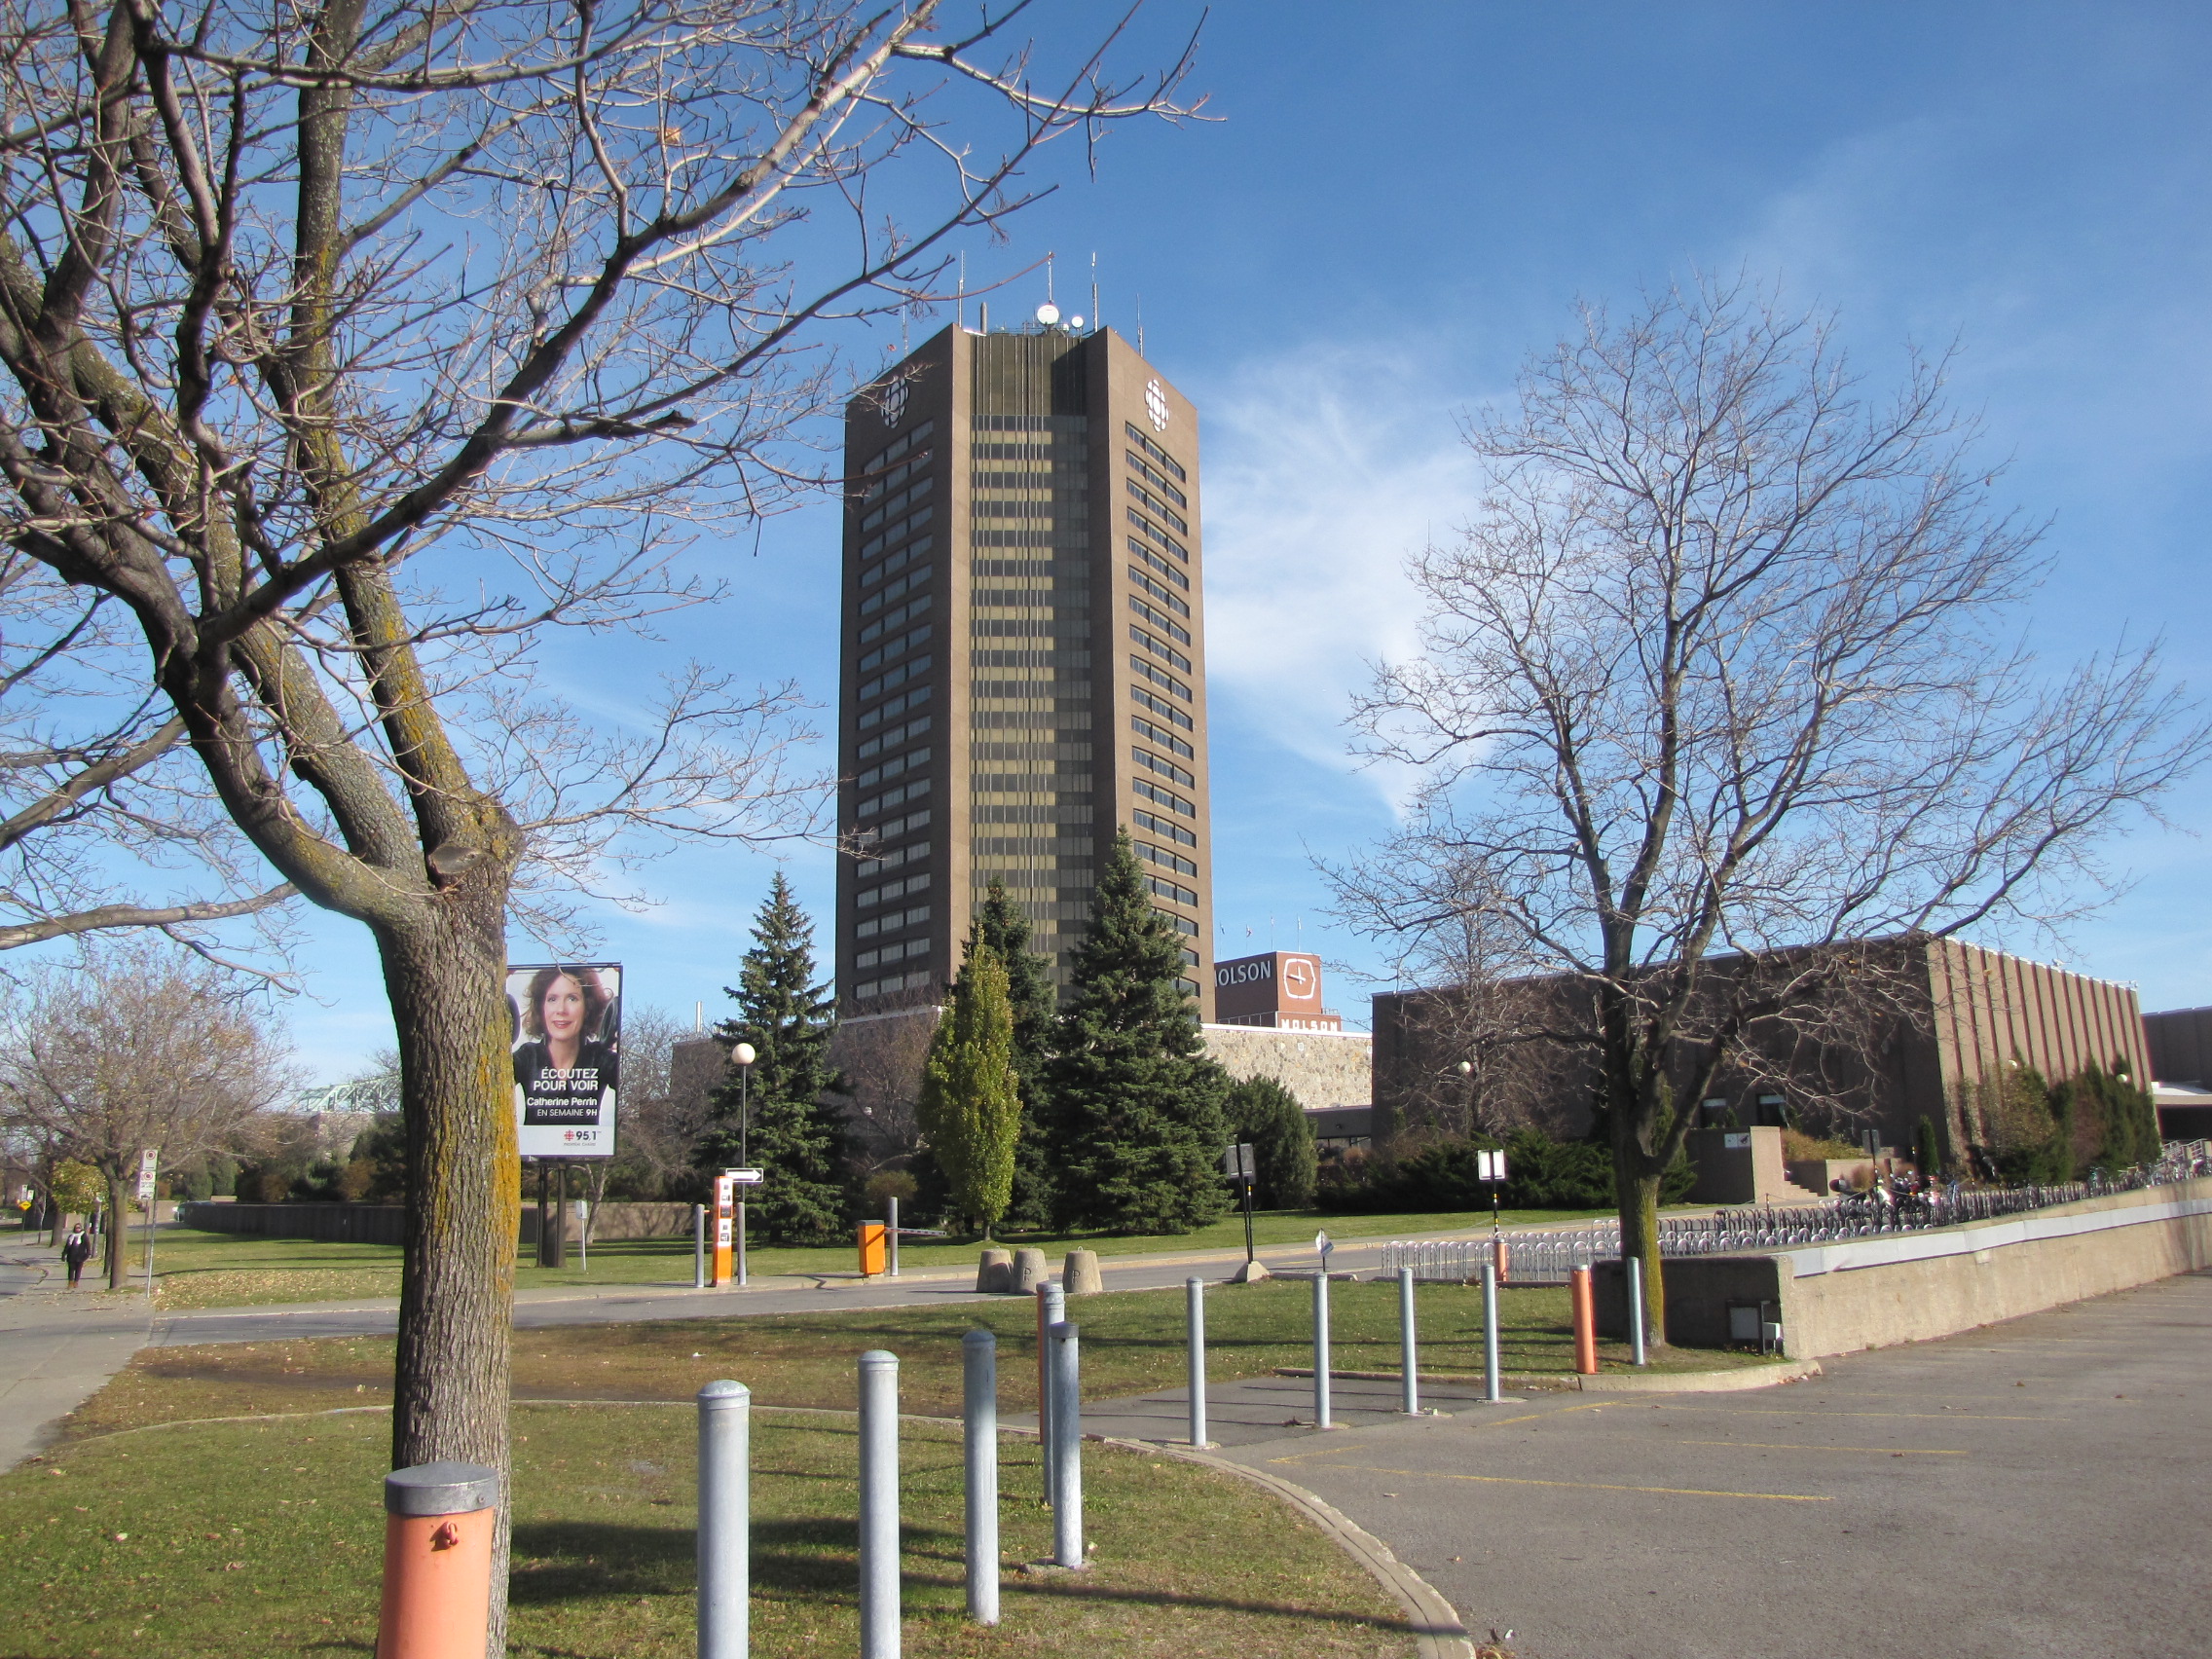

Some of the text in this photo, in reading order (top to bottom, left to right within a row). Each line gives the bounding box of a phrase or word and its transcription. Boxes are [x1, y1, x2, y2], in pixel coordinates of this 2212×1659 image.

[1214, 960, 1272, 987] OLSON
[1281, 1018, 1338, 1032] MOLSON
[541, 1066, 599, 1079] ÉCOUTEZ
[534, 1080, 599, 1090] POUR VOIR
[527, 1097, 598, 1106] Catherine Perrin
[575, 1130, 597, 1141] 95,1
